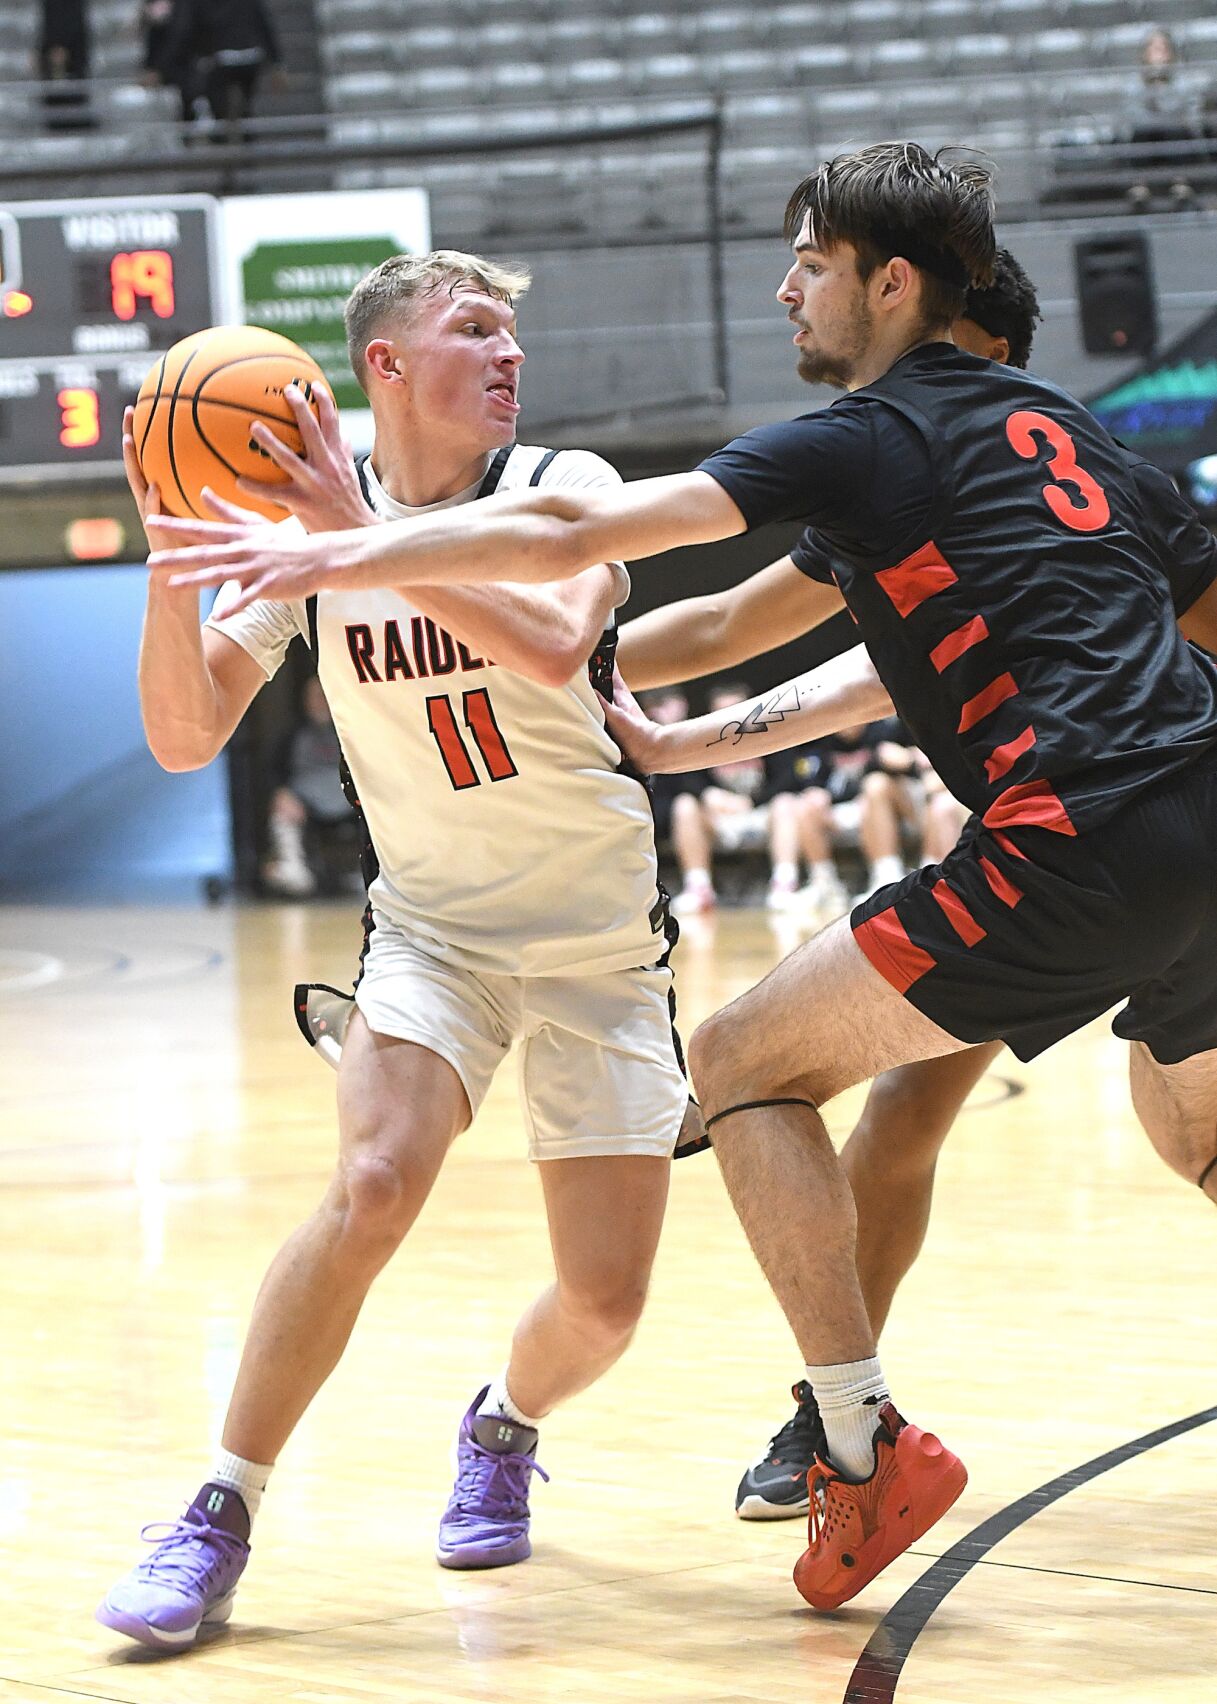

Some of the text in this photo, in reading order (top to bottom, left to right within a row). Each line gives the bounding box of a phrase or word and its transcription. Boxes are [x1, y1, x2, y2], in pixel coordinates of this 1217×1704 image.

[111, 251, 174, 320] 19
[58, 388, 100, 448] 3
[1006, 411, 1110, 531] 3
[345, 616, 498, 683] RAID
[425, 687, 519, 790] 11
